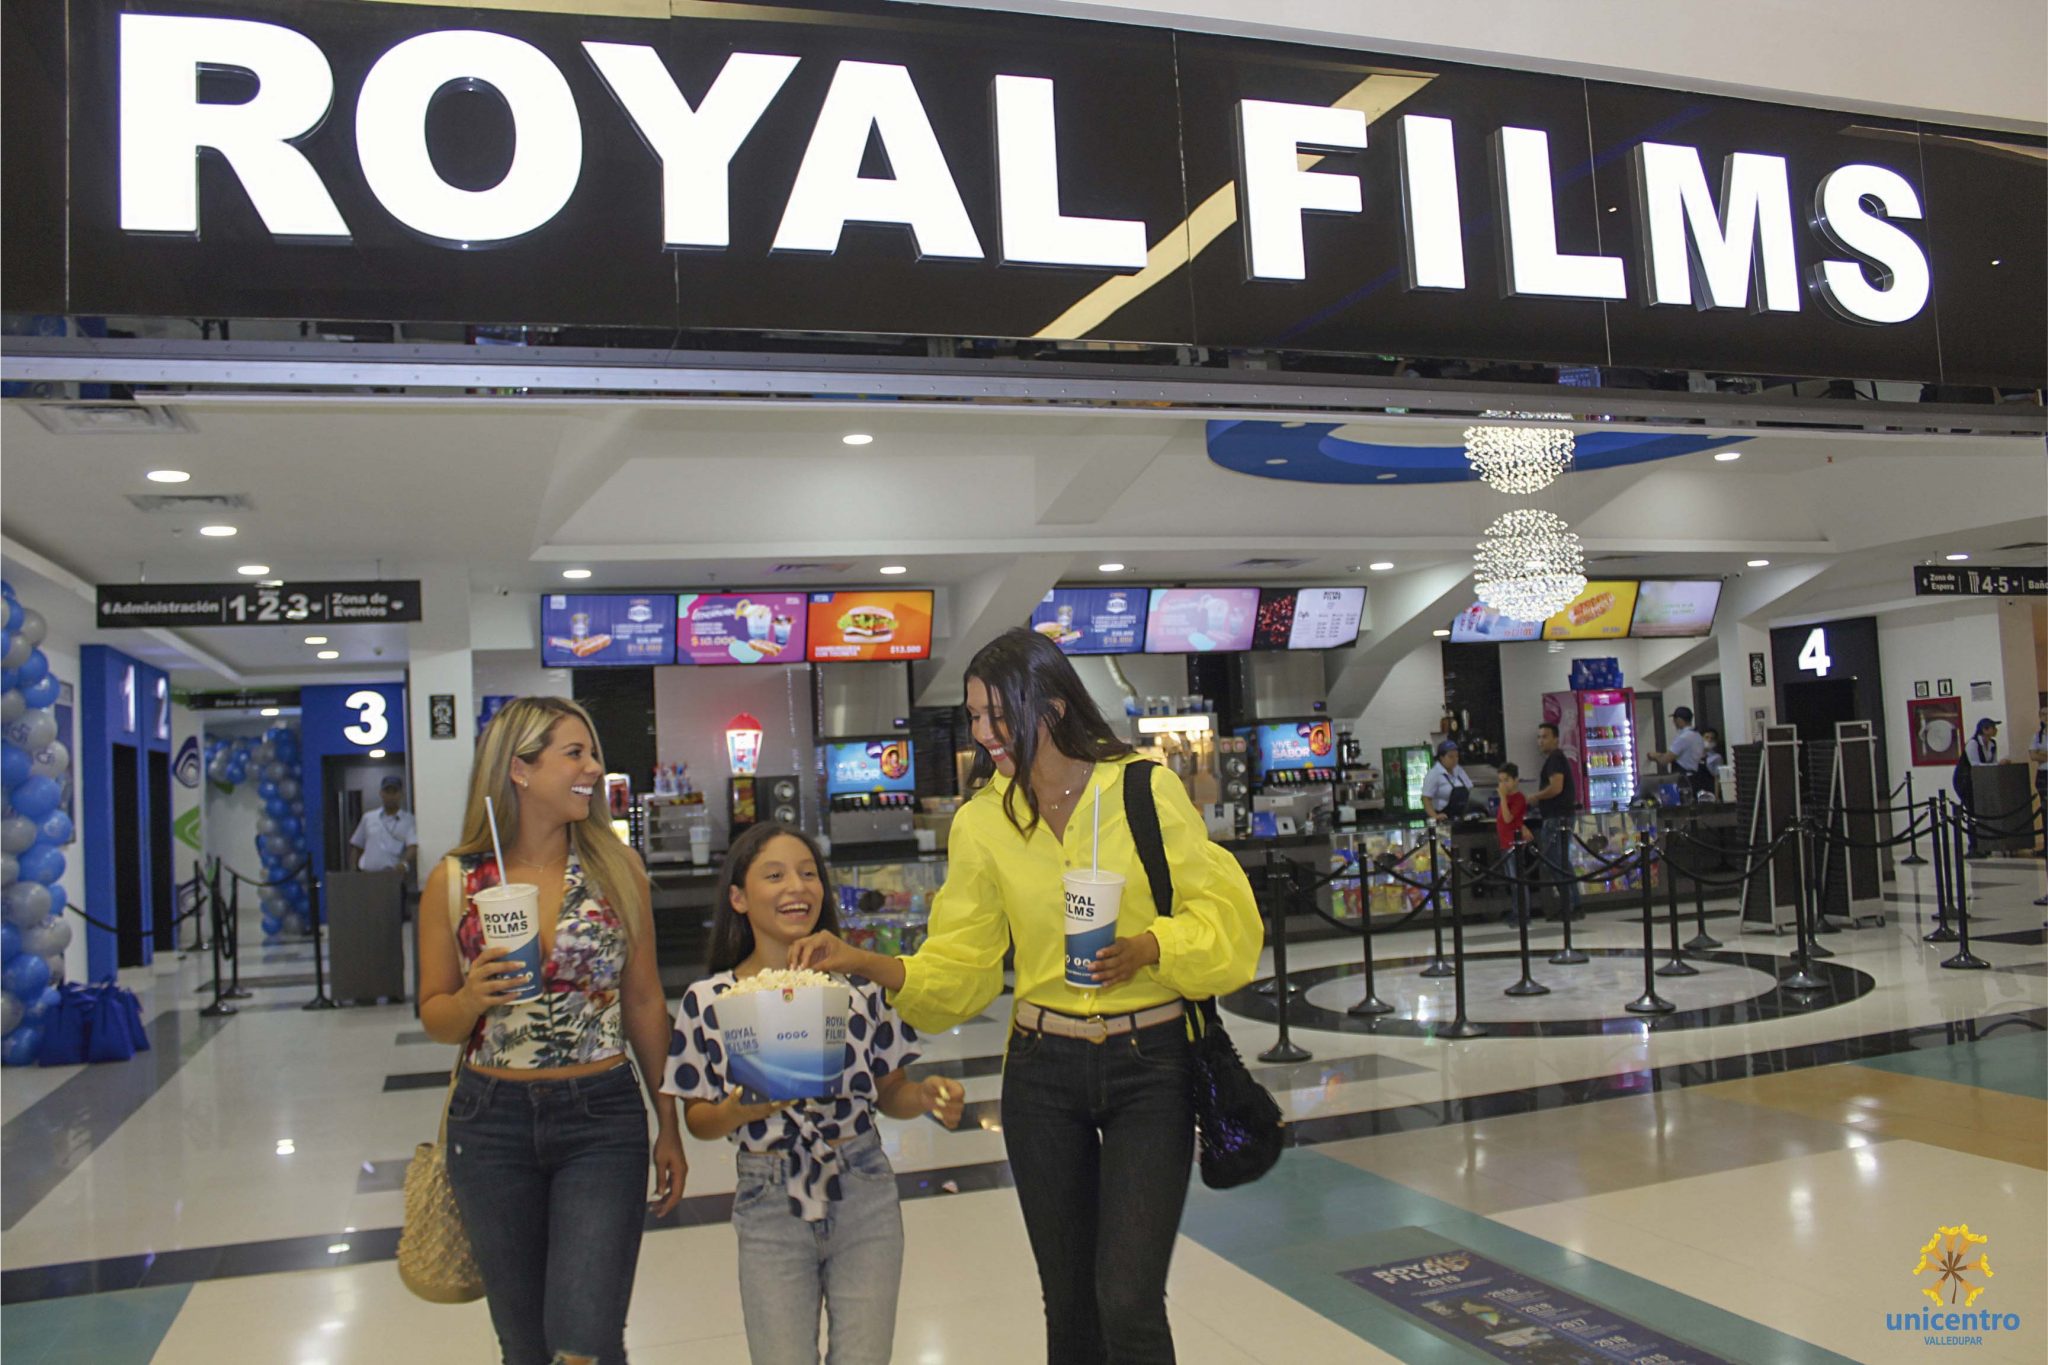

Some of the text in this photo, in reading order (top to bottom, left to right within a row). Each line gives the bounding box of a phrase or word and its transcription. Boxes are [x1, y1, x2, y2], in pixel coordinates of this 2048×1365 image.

[118, 13, 1931, 325] ROYAL FILMS
[332, 592, 388, 605] Zona de
[112, 601, 220, 615] Administración
[333, 605, 388, 617] Eventos
[1798, 627, 1832, 677] 4
[122, 664, 136, 733] 1
[155, 676, 169, 740] 2
[343, 690, 389, 746] 3
[1272, 747, 1310, 759] SABOR
[836, 768, 881, 780] SABOR
[1064, 891, 1095, 907] OYAL
[484, 910, 528, 924] ROYAL
[1065, 904, 1094, 918] ILMS
[486, 920, 529, 934] FILMS
[826, 1015, 846, 1027] ROYAL
[725, 1026, 757, 1041] ROYAL
